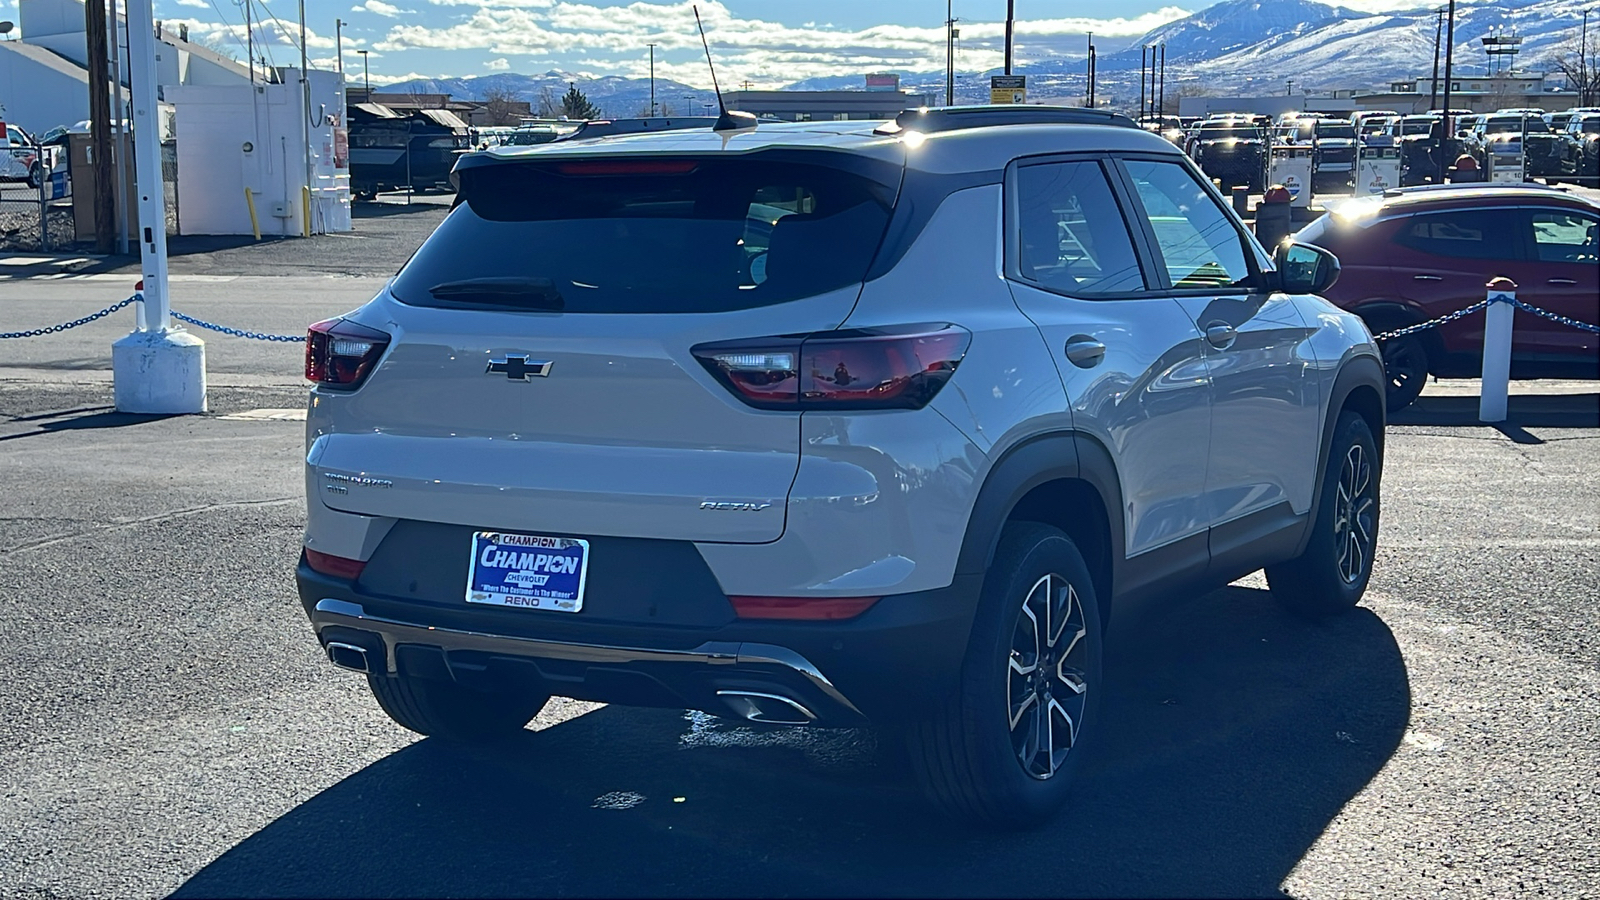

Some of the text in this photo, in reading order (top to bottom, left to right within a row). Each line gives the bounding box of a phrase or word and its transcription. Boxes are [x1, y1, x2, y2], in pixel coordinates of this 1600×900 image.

[700, 501, 771, 511] ACTIV
[503, 535, 557, 548] CHAMPION
[480, 545, 579, 574] CHAMPION
[507, 573, 546, 584] CHEVROLET
[500, 585, 509, 593] The
[510, 586, 534, 595] Customer
[540, 588, 550, 597] The
[504, 595, 540, 607] RENO
